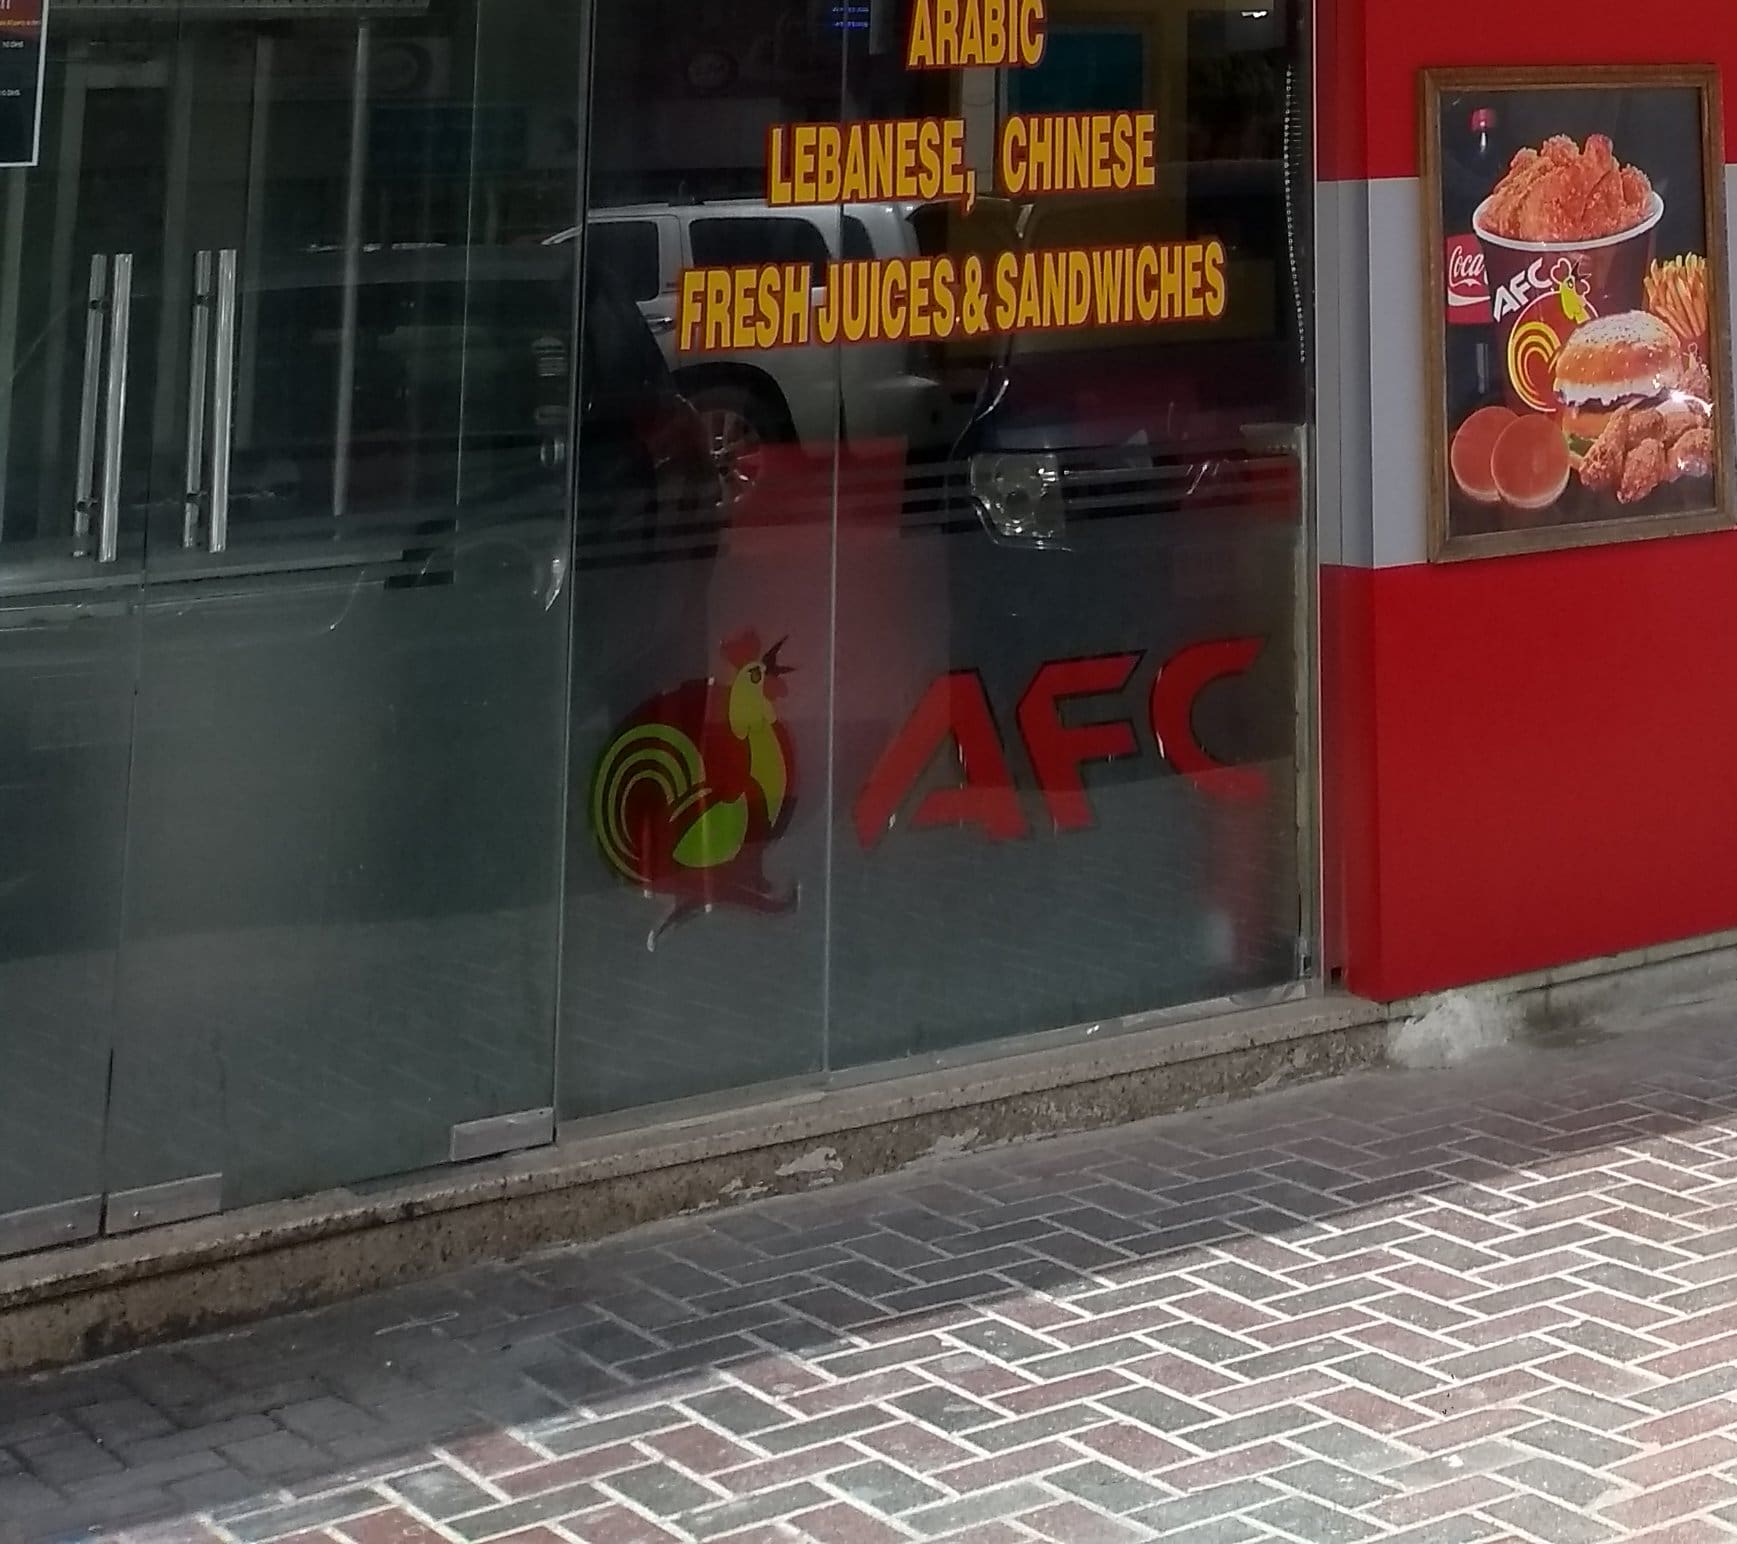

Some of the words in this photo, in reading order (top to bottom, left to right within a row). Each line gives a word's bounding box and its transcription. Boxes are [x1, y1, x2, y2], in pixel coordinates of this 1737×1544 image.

[769, 120, 975, 212] LEBANESE,
[1002, 113, 1155, 194] CHINESE
[679, 264, 811, 350] FRESH
[817, 253, 955, 343] JUICES
[962, 255, 990, 335] &
[996, 241, 1226, 330] SANDWICHES
[1493, 257, 1553, 323] AFC
[852, 635, 1271, 850] AFC
